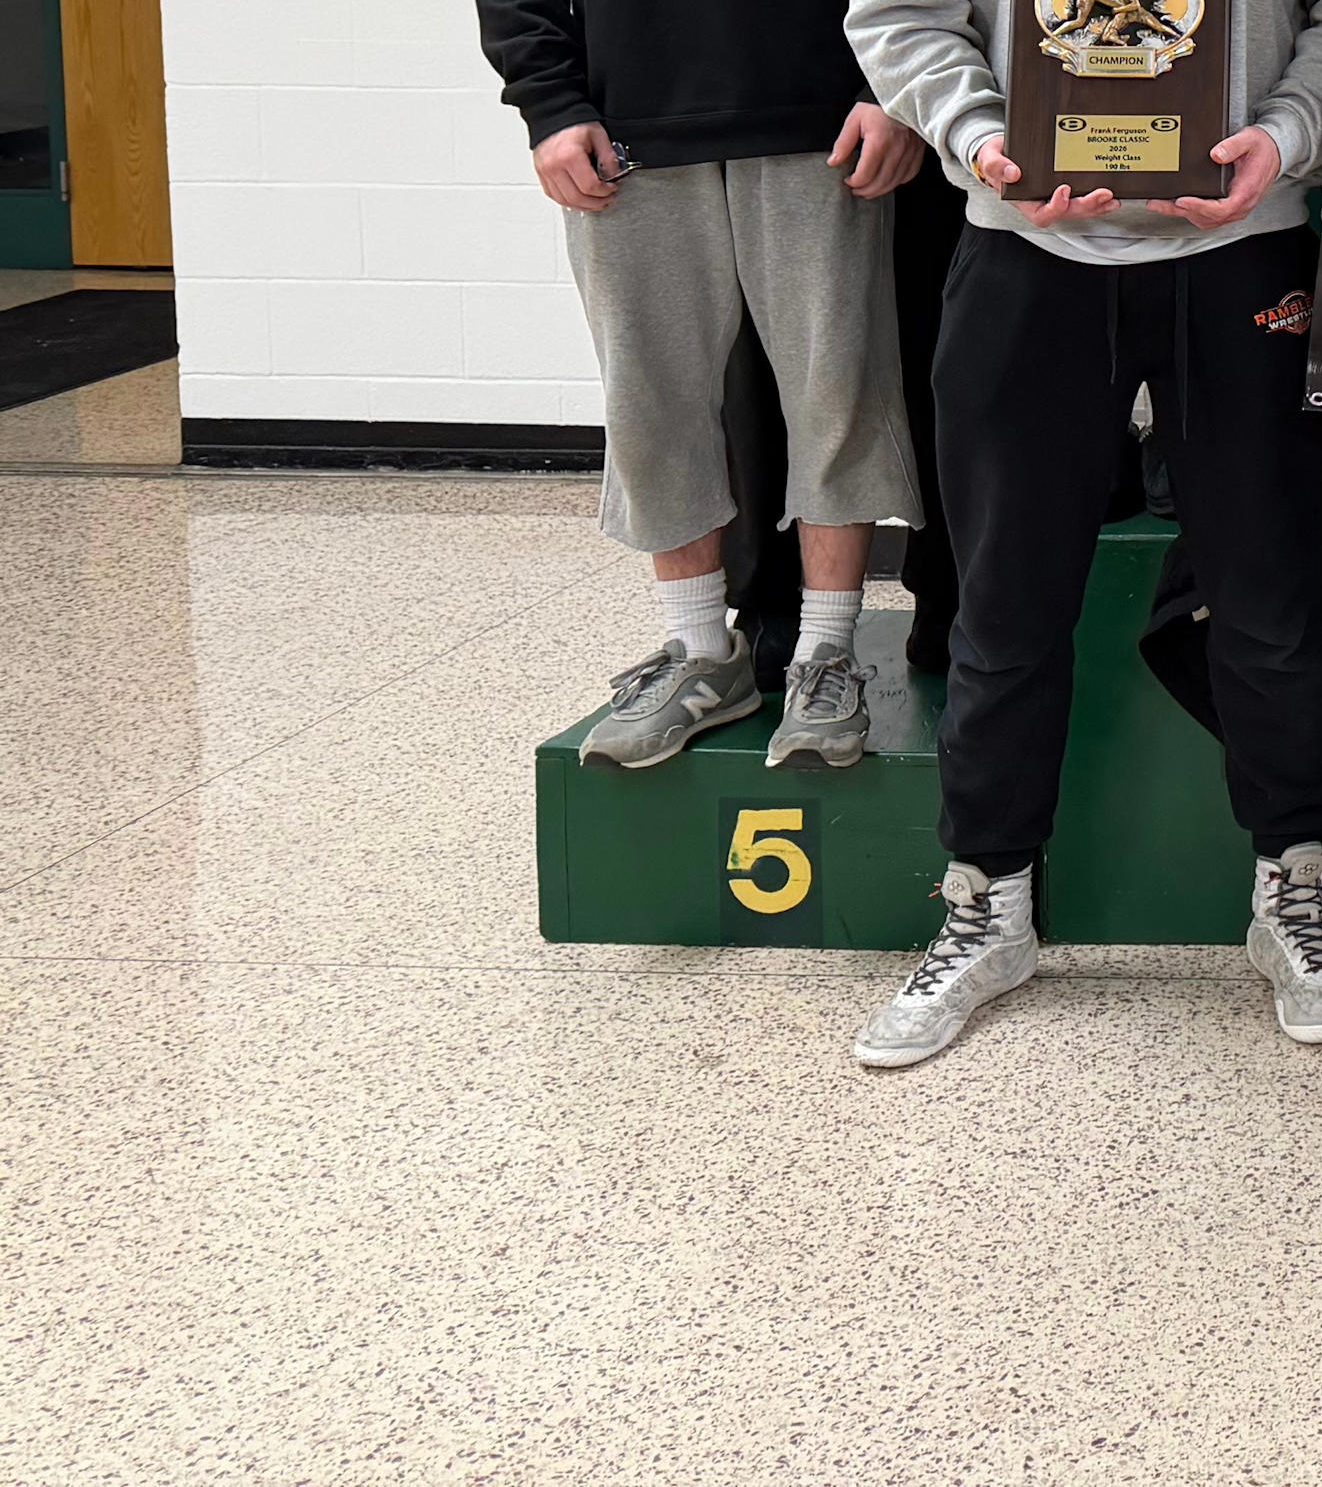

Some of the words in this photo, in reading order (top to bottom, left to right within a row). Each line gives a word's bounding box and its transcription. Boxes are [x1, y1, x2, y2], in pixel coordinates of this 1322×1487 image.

[1089, 55, 1144, 66] CHAMPION
[1095, 154, 1121, 162] Weight
[727, 808, 812, 914] 5
